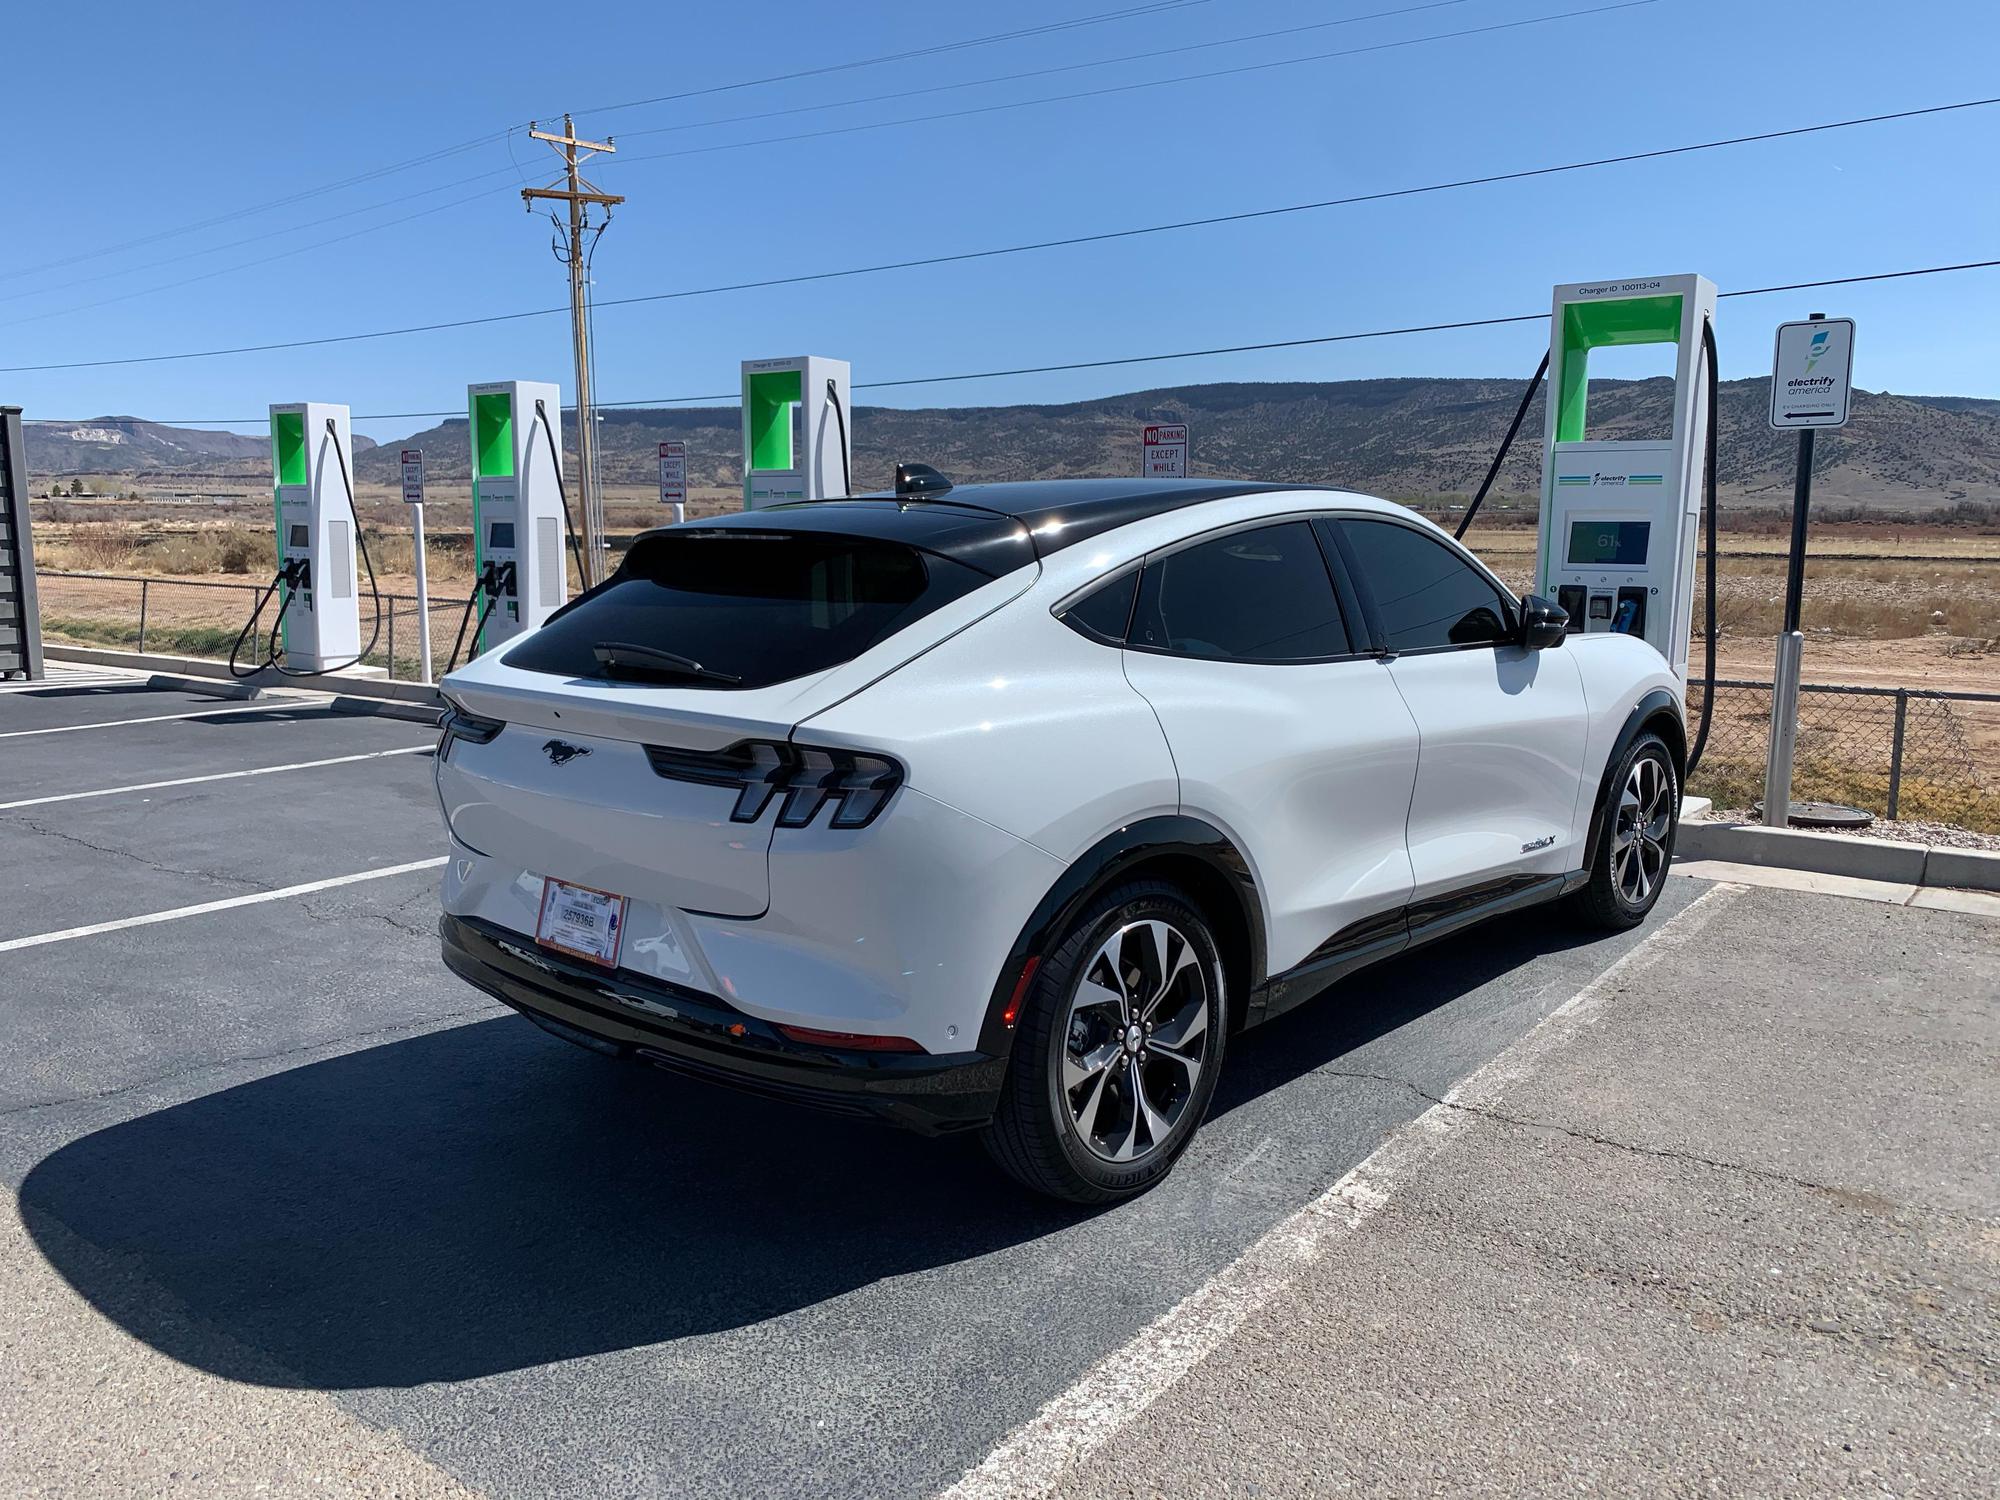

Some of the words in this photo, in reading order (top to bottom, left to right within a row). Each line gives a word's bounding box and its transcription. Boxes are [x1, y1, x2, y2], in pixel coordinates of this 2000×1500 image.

[1579, 286, 1608, 295] Charger
[1622, 282, 1660, 291] 100113-04
[1788, 376, 1835, 387] electrify
[1788, 386, 1831, 395] america
[1146, 430, 1158, 443] NO
[1159, 430, 1185, 440] PARKING
[1151, 449, 1178, 459] EXCEPT
[1153, 463, 1176, 472] WHILE
